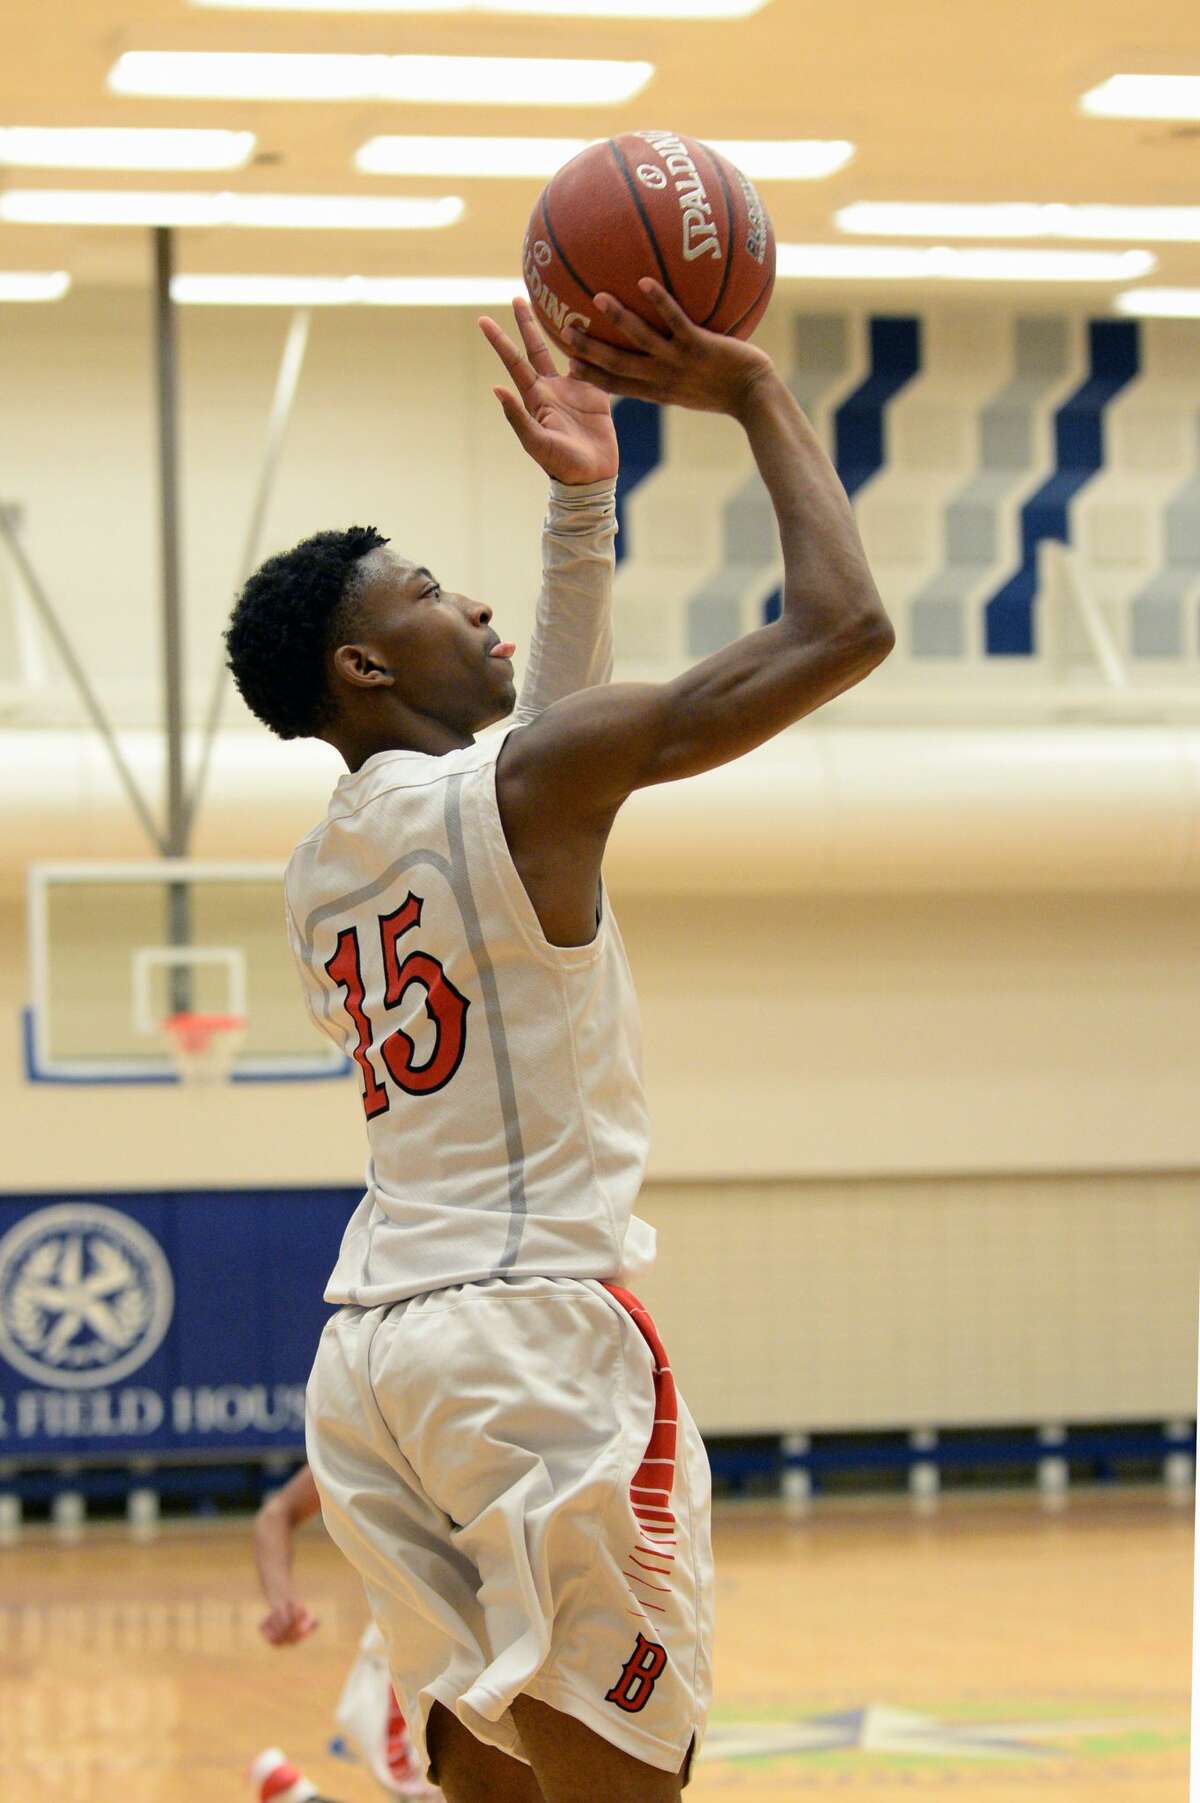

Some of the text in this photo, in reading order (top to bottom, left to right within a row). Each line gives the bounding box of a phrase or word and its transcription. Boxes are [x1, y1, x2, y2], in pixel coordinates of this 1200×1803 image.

[324, 890, 471, 1122] 15
[16, 1386, 165, 1438] FIELD
[604, 1631, 668, 1713] B
